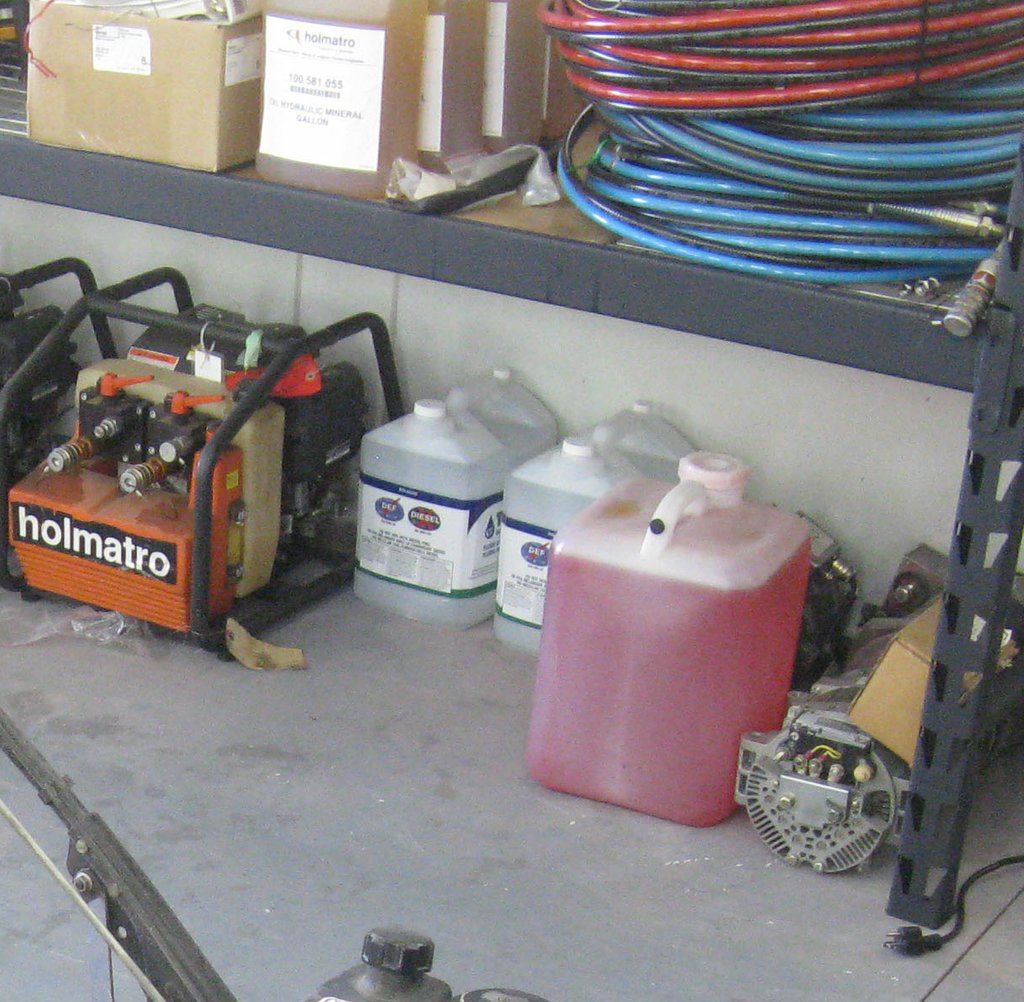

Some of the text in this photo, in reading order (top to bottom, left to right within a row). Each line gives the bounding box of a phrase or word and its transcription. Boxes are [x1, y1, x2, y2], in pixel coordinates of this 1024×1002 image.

[304, 31, 356, 48] holmatro
[289, 73, 344, 89] 100.581.055
[280, 99, 324, 116] HYDRAULIC
[325, 108, 364, 121] MINERAL
[296, 114, 329, 127] GALLON
[381, 501, 397, 510] DEF
[410, 511, 441, 525] DIESEL
[18, 506, 171, 578] holmatro
[528, 545, 546, 557] DEF
